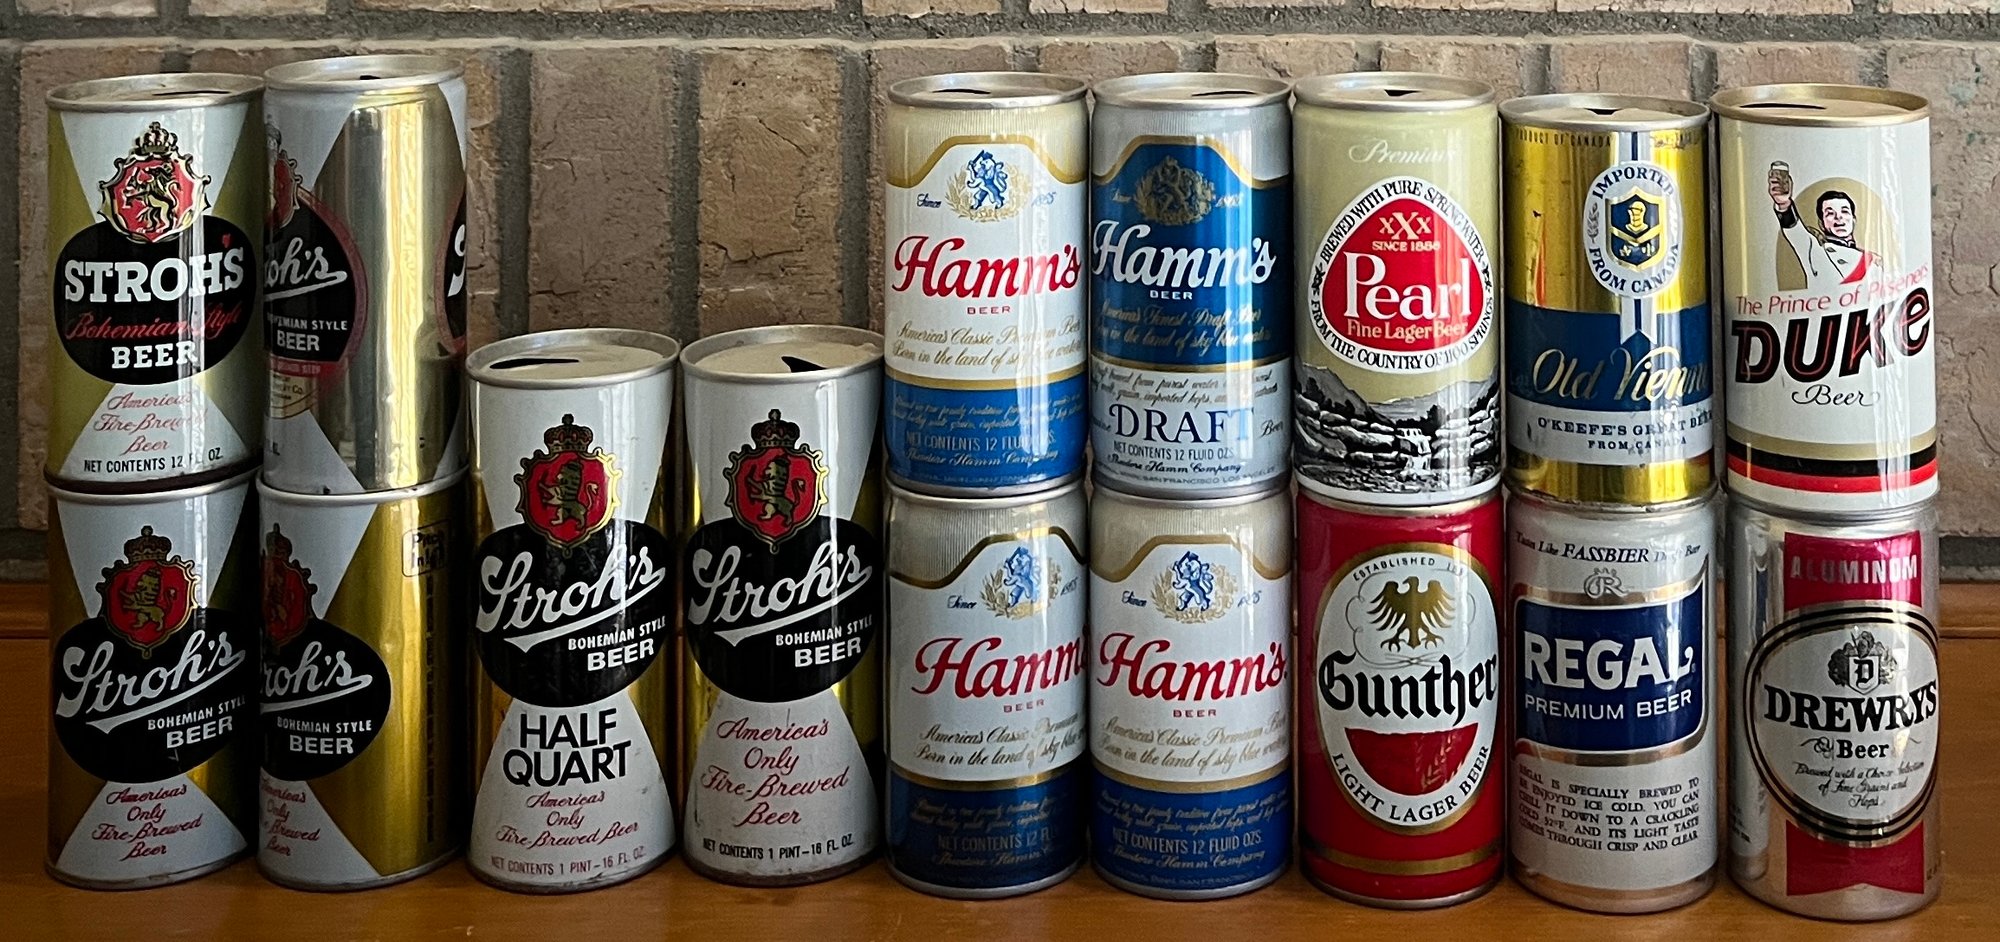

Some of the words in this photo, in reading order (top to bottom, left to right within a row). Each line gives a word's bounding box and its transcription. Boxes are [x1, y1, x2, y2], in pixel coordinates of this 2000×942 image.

[1349, 139, 1457, 164] Premium
[1570, 134, 1612, 147] CANADA
[1592, 166, 1676, 200] IMPORTED
[1320, 214, 1356, 264] BREWED
[1351, 189, 1386, 223] WITH
[1382, 179, 1424, 198] PURE
[1424, 187, 1465, 227] SPRING
[1462, 217, 1485, 263] WATER
[1092, 220, 1276, 289] Hamm's
[1372, 241, 1407, 252] SINCE
[65, 233, 244, 303] STROH'S
[264, 237, 348, 288] oh's
[892, 236, 1081, 298] Hamm's
[1589, 247, 1626, 291] FROM
[1631, 243, 1680, 293] CANADA
[1150, 290, 1192, 300] BEER
[1344, 252, 1472, 320] Pearl
[967, 306, 1011, 315] BEER
[1736, 295, 1763, 315] The
[1769, 294, 1831, 314] Prince
[1839, 284, 1860, 307] of
[66, 311, 190, 340] Bohemian
[311, 320, 348, 331] STYLE
[897, 320, 948, 344] America's
[950, 328, 993, 346] Classic
[1311, 300, 1333, 340] FROM
[1330, 333, 1355, 359] THE
[1357, 349, 1423, 369] COUNTRY
[1468, 297, 1494, 349] SPRINGS
[1348, 319, 1382, 338] Fine
[1384, 321, 1433, 343] Lager
[1433, 320, 1469, 338] Beer
[276, 330, 320, 351] BEER
[112, 340, 198, 369] BEER
[934, 347, 951, 366] the
[954, 348, 990, 366] land
[1533, 349, 1604, 400] Old
[1791, 384, 1880, 407] Beer
[1109, 404, 1254, 443] DRAFT
[1259, 419, 1284, 438] Beer
[1538, 417, 1627, 435] O'KEEFE'S
[119, 435, 170, 456] Beer
[924, 435, 980, 451] CONTENTS
[985, 436, 997, 451] 12
[1113, 440, 1128, 454] NET
[1129, 442, 1172, 460] CONTENTS
[1175, 450, 1185, 461] 12
[1188, 448, 1214, 460] FLUID
[1588, 440, 1628, 450] FROM
[84, 460, 102, 472] NET
[106, 457, 166, 472] CONTENTS
[171, 456, 183, 468] 12
[950, 450, 1001, 467] Hamm
[1144, 459, 1189, 474] Hamm
[1190, 461, 1243, 478] Company
[1562, 543, 1648, 563] FASSBIER
[1352, 557, 1436, 582] ESTABLISHED
[476, 544, 666, 633] Stroh's
[688, 541, 872, 625] Stroh's
[947, 594, 977, 609] Since
[568, 628, 634, 651] BOHEMIAN
[639, 616, 666, 637] STYLE
[775, 626, 842, 647] BOHEMIAN
[847, 613, 873, 635] STYLE
[587, 638, 654, 672] BEER
[794, 636, 861, 669] BEER
[1524, 631, 1694, 690] REGAL
[56, 630, 245, 718] Stroh's
[263, 641, 373, 697] roh's
[1097, 632, 1286, 701] Hamm's
[1854, 659, 1874, 689] D
[1318, 650, 1497, 726] Gunther
[147, 707, 213, 731] BOHEMIAN
[218, 695, 246, 716] STYLE
[1003, 699, 1045, 713] BEER
[1173, 709, 1216, 718] BEER
[1525, 693, 1624, 720] PREMIUM
[1637, 689, 1691, 718] BEER
[1764, 680, 1937, 732] DREWRYS
[167, 715, 233, 749] BEER
[277, 716, 330, 734] BOHEMIAN
[335, 720, 372, 734] STYLE
[520, 708, 617, 749] HALF
[716, 717, 829, 741] America's
[920, 724, 983, 744] America's
[1102, 716, 1154, 743] America's
[1157, 729, 1201, 746] Classic
[289, 735, 354, 755] BEER
[914, 744, 945, 763] Born
[967, 748, 989, 766] the
[1836, 739, 1889, 759] Beer
[503, 740, 631, 787] QUART
[744, 746, 799, 775] Only
[1140, 749, 1159, 765] the
[1161, 750, 1196, 767] land
[701, 765, 850, 801] Fire-Brewed
[1332, 753, 1385, 812] LIGHT
[1390, 794, 1458, 823] LAGER
[1458, 745, 1489, 798] BEER
[1520, 765, 1543, 783] REGAL
[1569, 784, 1629, 799] SPECIALLY
[1639, 784, 1682, 799] BREWED
[1835, 767, 1856, 779] with
[527, 791, 605, 808] America's
[1533, 785, 1576, 806] ENJOYED
[1584, 800, 1602, 810] ICE
[1654, 797, 1677, 810] YOU
[1682, 790, 1699, 804] CAN
[1818, 779, 1832, 796] of
[127, 803, 167, 823] Only
[546, 807, 585, 829] Only
[734, 801, 801, 827] Beer
[1520, 791, 1540, 809] CHILL
[1546, 804, 1556, 814] IT
[1561, 809, 1599, 823] DOWN
[1606, 815, 1623, 825] TO
[1646, 803, 1699, 824] CRACKLING
[92, 815, 202, 843] Fire-Brewed
[496, 825, 600, 849] Fire-Brewed
[599, 822, 638, 845] Beer
[1575, 825, 1600, 836] AND
[1609, 828, 1626, 838] ITS
[1634, 826, 1668, 838] LIGHT
[1675, 816, 1699, 832] TASTE
[120, 841, 167, 862] Beer
[703, 838, 716, 850] NET
[719, 845, 763, 859] CONTENTS
[960, 835, 1022, 850] CONTENTS
[1130, 834, 1188, 854] CONTENTS
[1192, 840, 1205, 854] 12
[1209, 837, 1240, 852] FLUID
[1547, 829, 1602, 850] THROUGH
[1607, 841, 1638, 851] CRISP
[1643, 839, 1667, 850] AND
[1671, 831, 1698, 846] CLEAR
[491, 856, 504, 869] NET
[508, 860, 554, 875] CONTENTS
[1156, 851, 1208, 869] Hamm
[1210, 851, 1265, 869] Company
